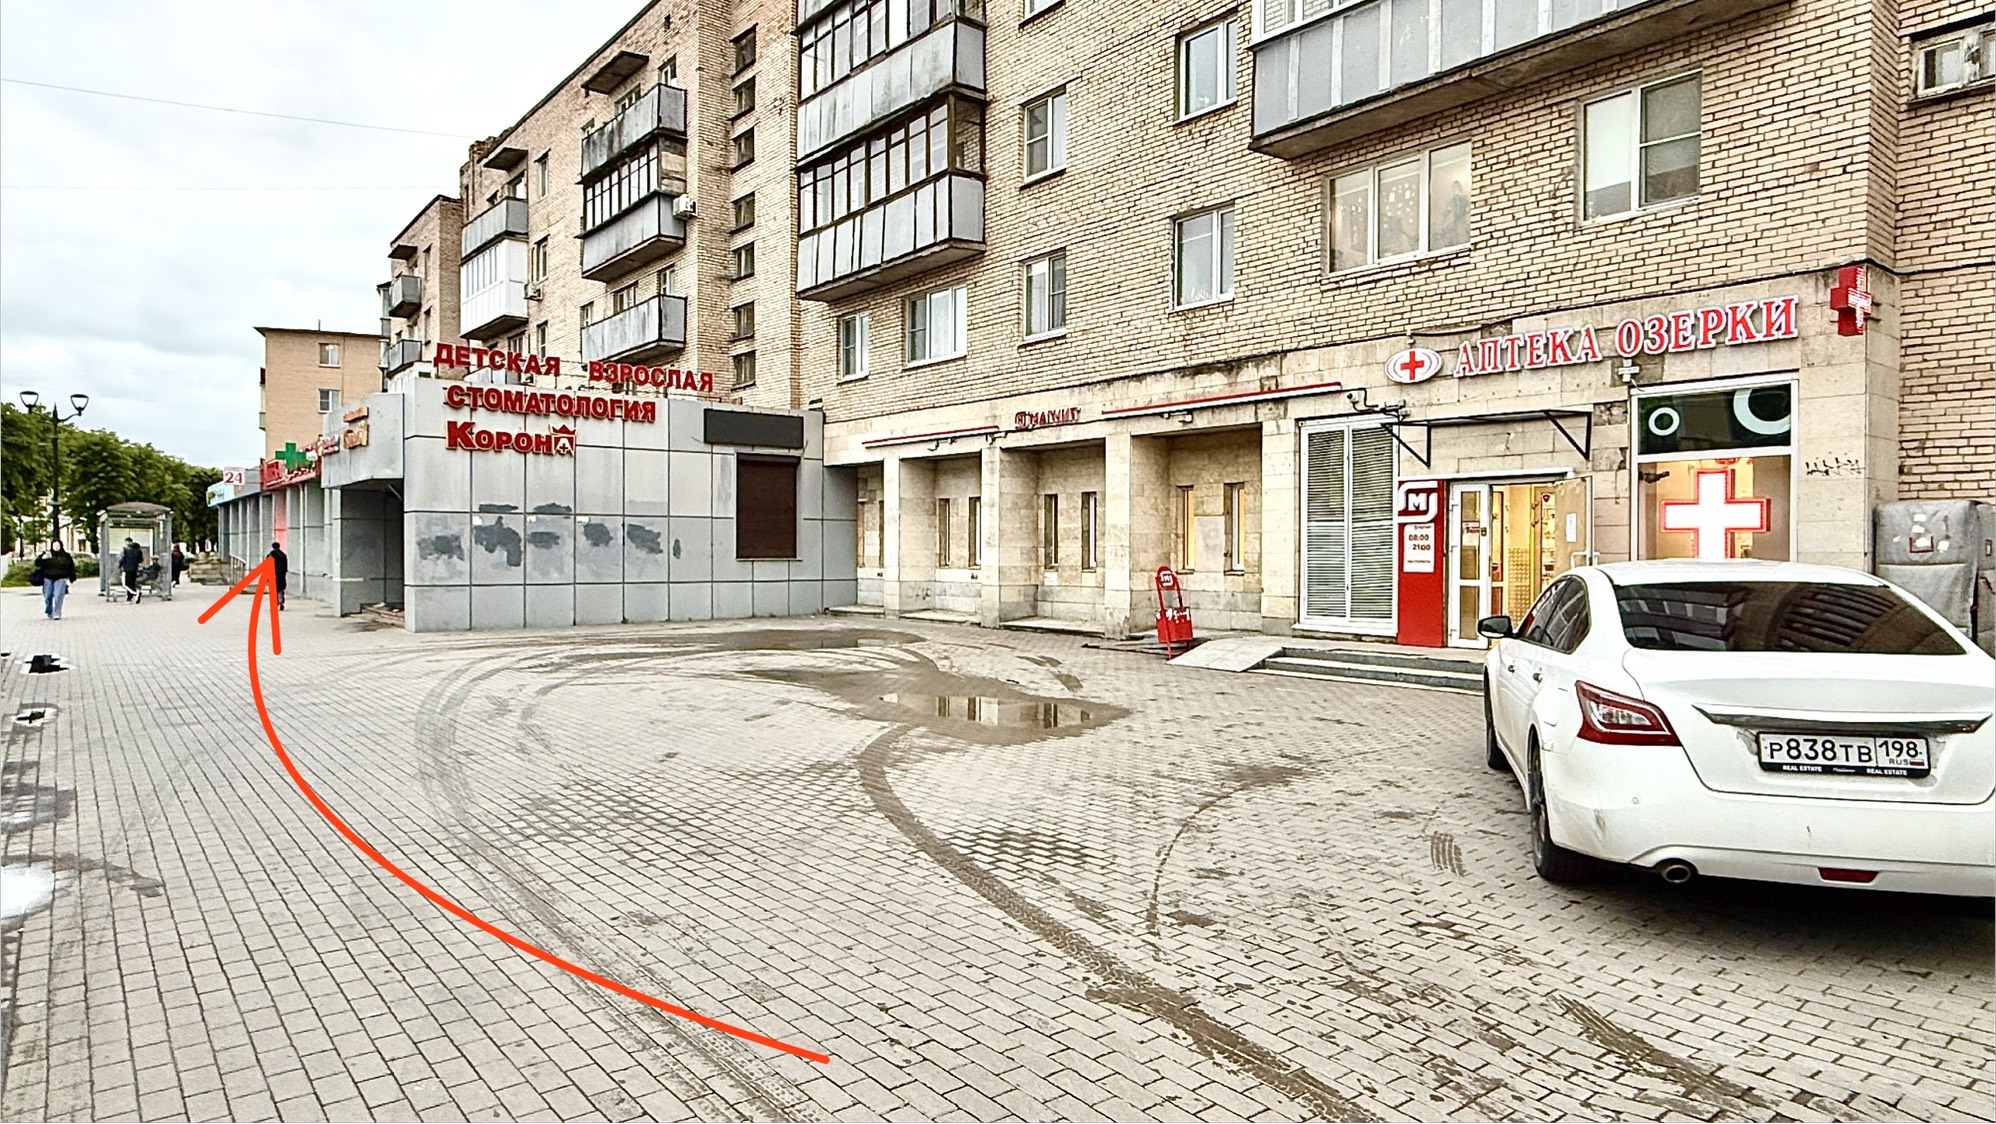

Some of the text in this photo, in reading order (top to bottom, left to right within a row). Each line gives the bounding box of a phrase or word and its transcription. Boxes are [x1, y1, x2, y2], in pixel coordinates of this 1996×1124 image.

[1454, 296, 1798, 377] АПТЕКА ОЗЕРКИ
[433, 342, 714, 393] ДЕТСКАЯ ВЗРОСЛАЯ
[446, 384, 656, 422] СТОМАТОЛОГИЯ
[225, 471, 243, 484] 24
[1878, 740, 1919, 758] 198
[1800, 765, 1823, 773] ESTATE
[1888, 757, 1909, 766] RUS
